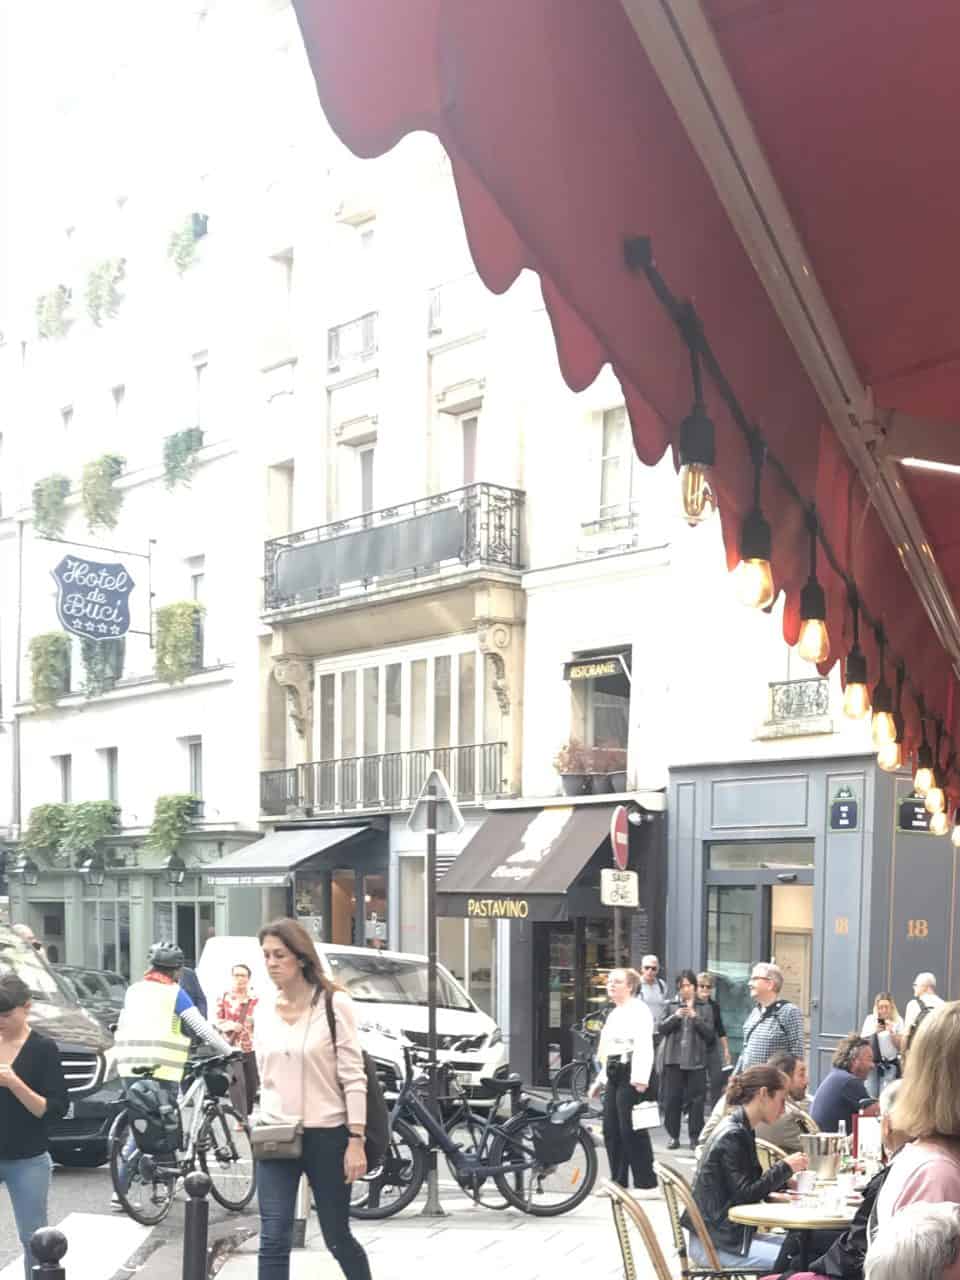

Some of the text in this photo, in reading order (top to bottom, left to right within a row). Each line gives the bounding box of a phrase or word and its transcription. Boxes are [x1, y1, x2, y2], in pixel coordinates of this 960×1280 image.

[63, 560, 127, 592] Hotel
[86, 588, 106, 603] de
[63, 593, 123, 622] Buci
[467, 897, 529, 918] PASTAVINO
[906, 919, 929, 937] 18
